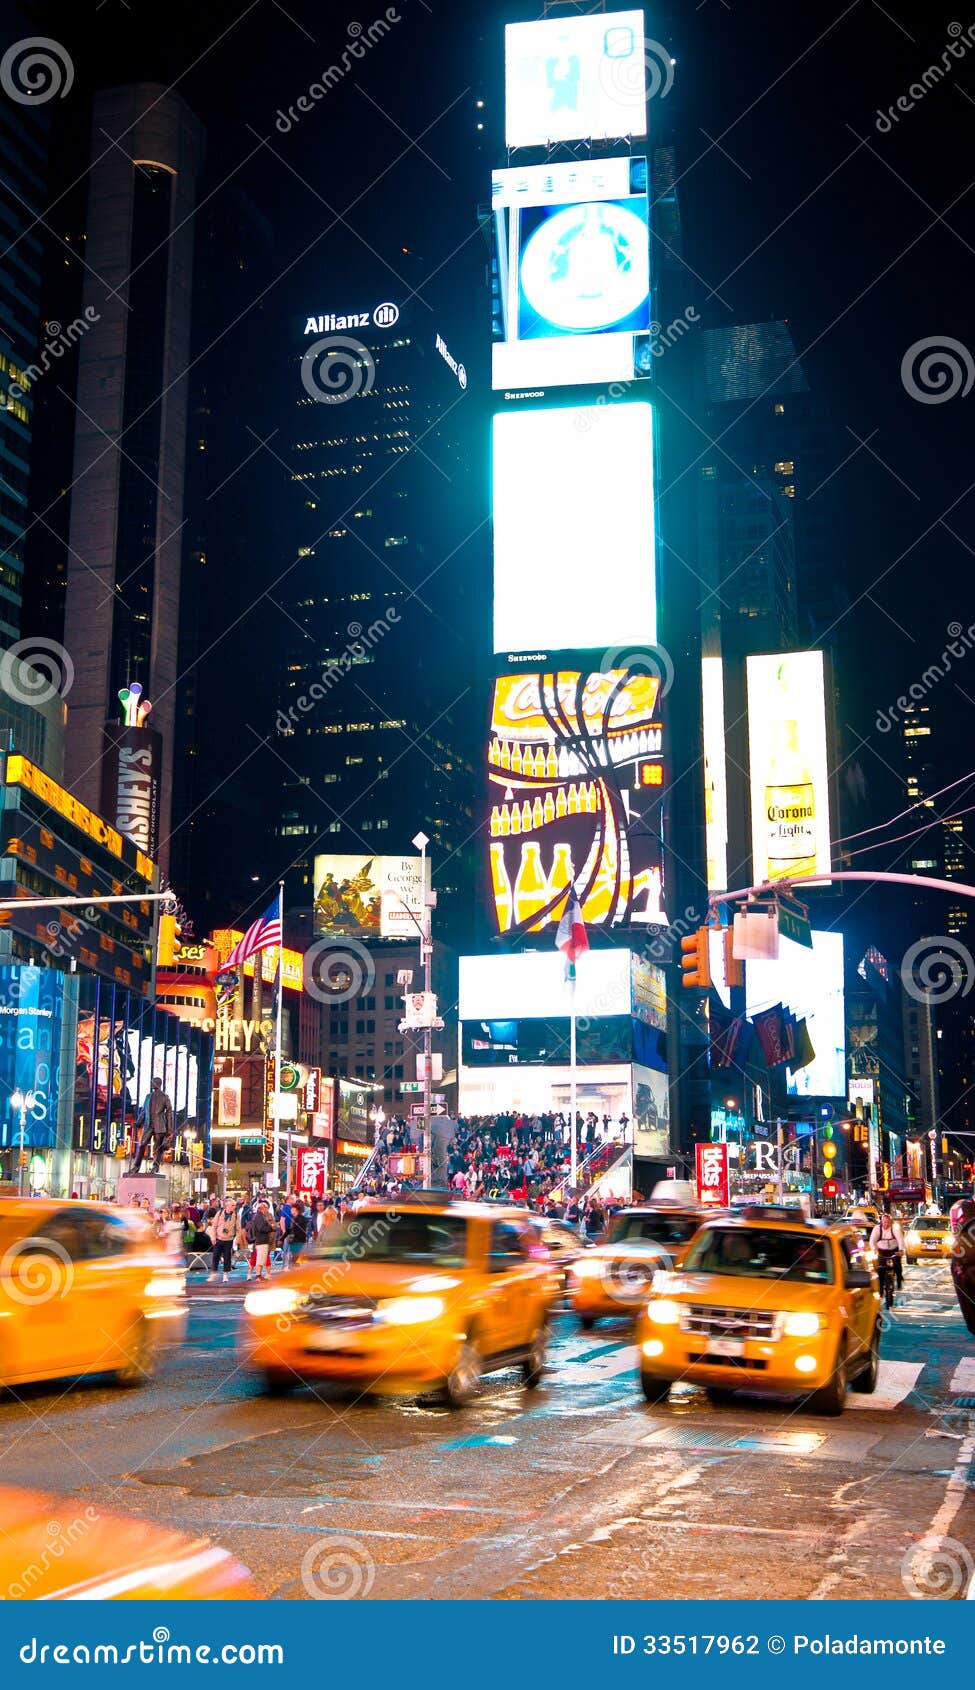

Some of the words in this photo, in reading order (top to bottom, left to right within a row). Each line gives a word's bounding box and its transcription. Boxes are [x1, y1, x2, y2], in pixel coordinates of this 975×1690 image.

[304, 312, 370, 335] Allianz
[436, 333, 458, 376] Allianz
[149, 779, 157, 834] CHOCOLATE
[768, 805, 812, 821] Corona
[778, 824, 804, 838] Light
[401, 861, 414, 873] By
[400, 884, 414, 893] we
[0, 1006, 27, 1016] Morgan
[29, 1007, 52, 1019] Stanley
[754, 1141, 779, 1171] R
[702, 1147, 723, 1187] tkts
